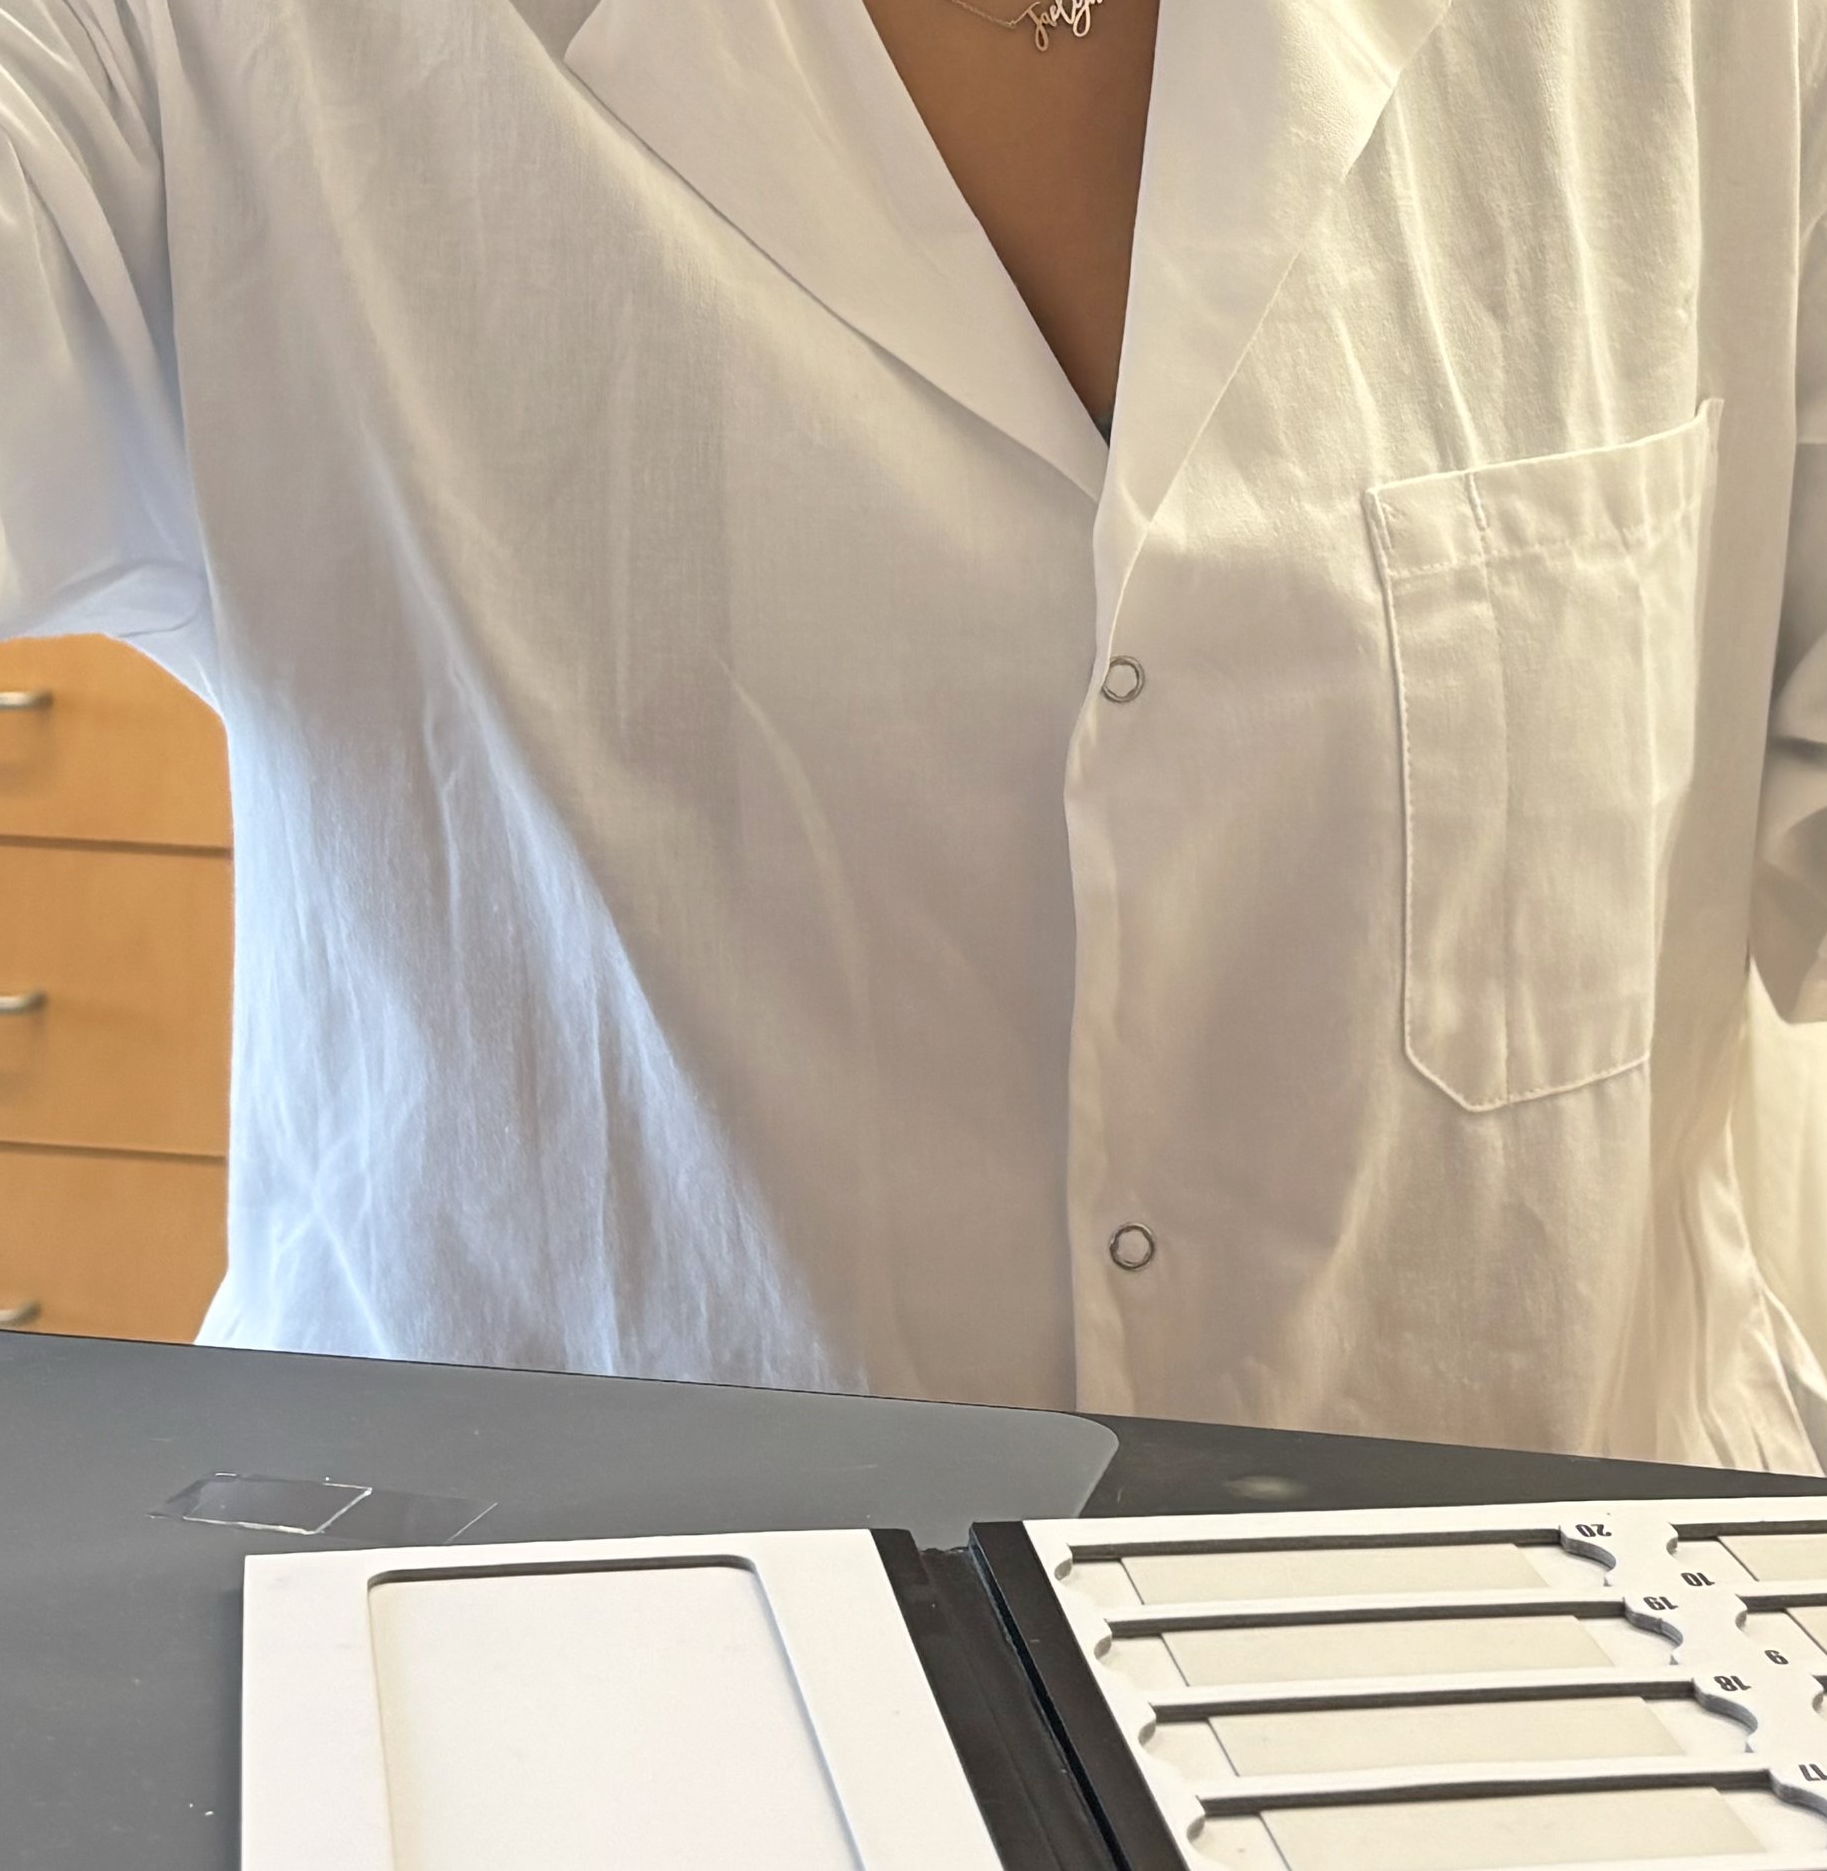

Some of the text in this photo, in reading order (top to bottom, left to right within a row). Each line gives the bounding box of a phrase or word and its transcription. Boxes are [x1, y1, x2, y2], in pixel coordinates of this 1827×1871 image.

[1575, 1524, 1612, 1537] 20
[1680, 1572, 1715, 1587] 10
[1643, 1596, 1678, 1611] 19
[1713, 1675, 1751, 1692] 18
